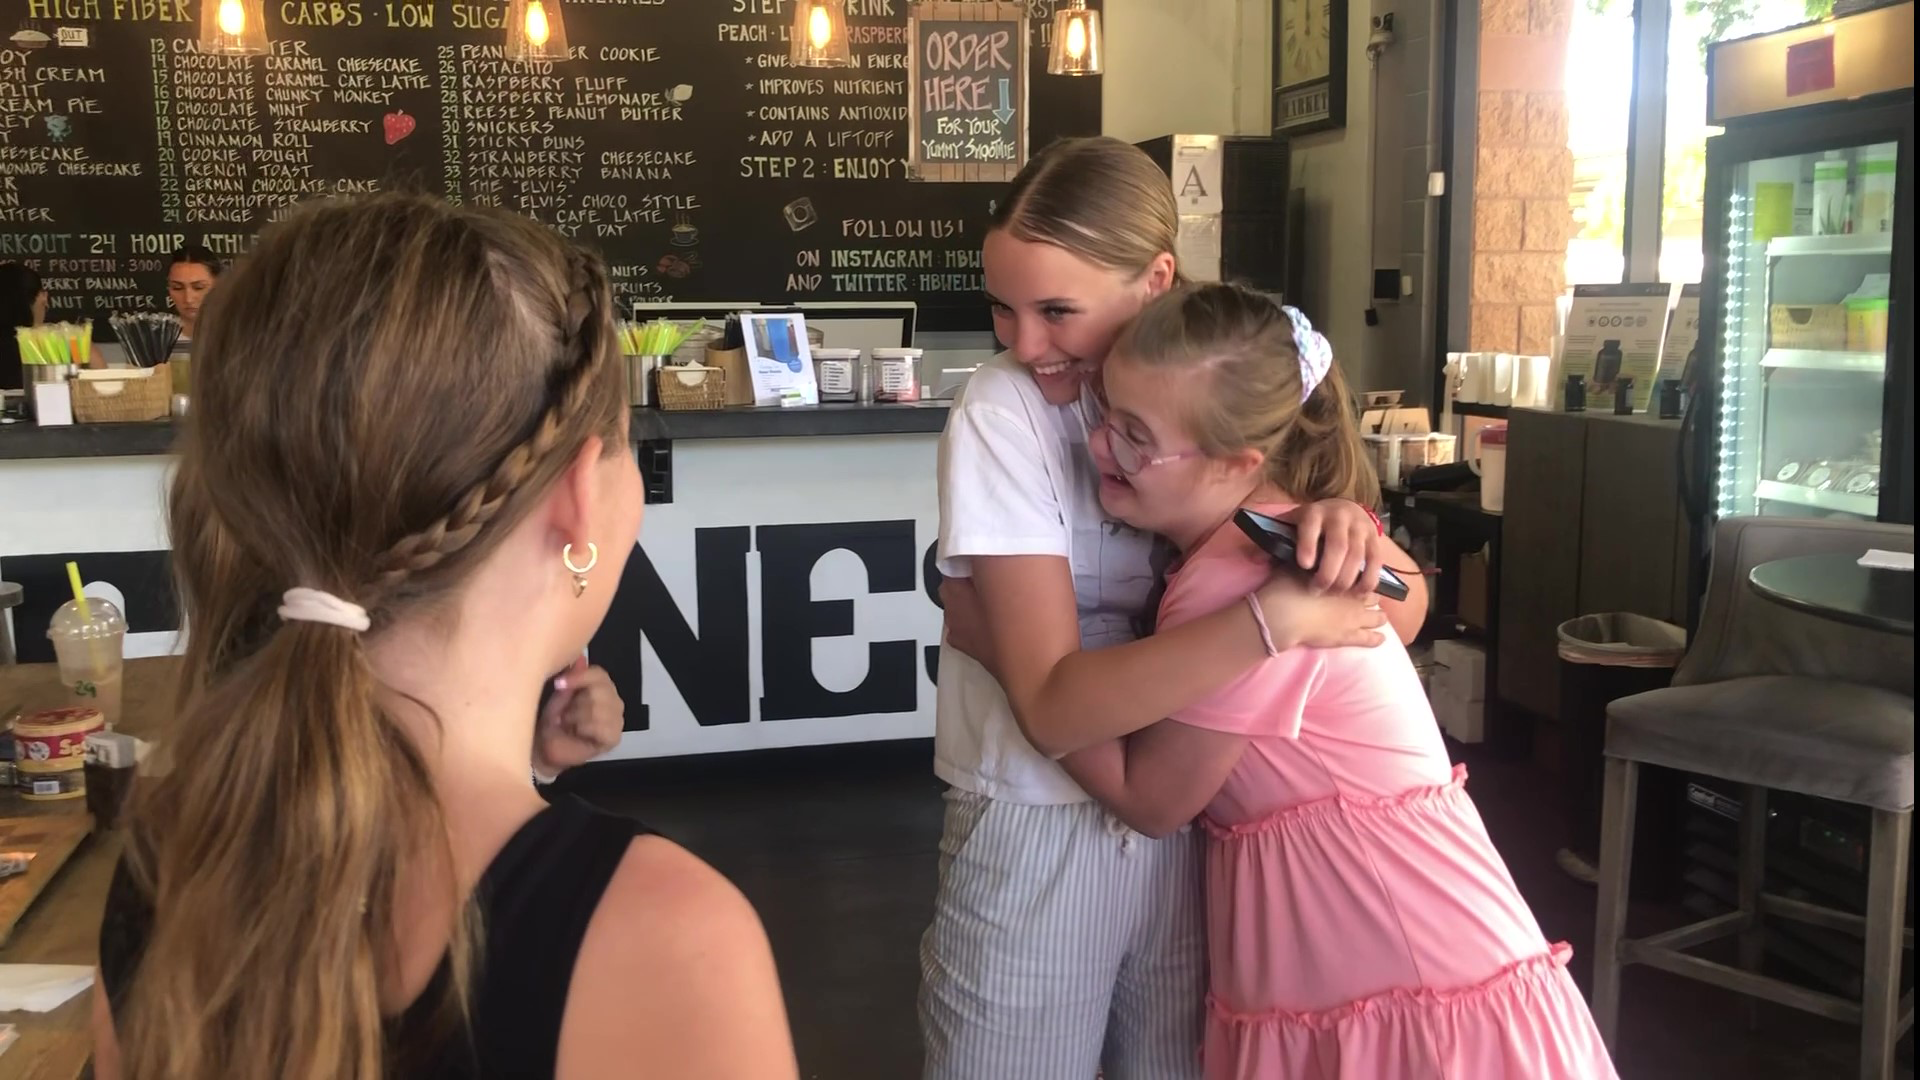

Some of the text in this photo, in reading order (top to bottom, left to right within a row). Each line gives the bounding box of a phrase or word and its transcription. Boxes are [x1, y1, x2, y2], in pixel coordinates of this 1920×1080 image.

[29, 0, 101, 19] HIGH
[113, 0, 194, 22] FIBER
[280, 1, 363, 26] CARBS
[387, 4, 434, 28] LOW
[846, 0, 895, 16] RINK
[61, 29, 84, 41] OUT
[718, 24, 768, 42] PEACH
[600, 46, 661, 62] COOKIE
[926, 31, 1012, 72] ORDER
[174, 55, 255, 71] CHOCOLATE
[265, 57, 328, 72] CARAMEL
[337, 58, 422, 74] CHEESECAKE
[0, 67, 105, 82] SH CREAM
[174, 71, 255, 86] CHOCOLATE
[265, 73, 330, 89] CARAMEL
[338, 75, 375, 89] CAFE
[381, 75, 431, 90] LATTE
[462, 74, 565, 91] RASPBERRY
[575, 76, 628, 91] FLUFF
[175, 86, 256, 101] CHOCOLATE
[265, 89, 323, 104] CHUNKY
[333, 90, 394, 106] MONKEY
[760, 79, 904, 96] IMPROVES NUTRIENT
[923, 74, 992, 113] HERE
[462, 90, 565, 105] RASPBERRY
[576, 92, 663, 107] LEMONADE
[176, 101, 258, 117] CHOCOLATE
[269, 103, 309, 118] MINT
[464, 105, 536, 120] REESE'S
[549, 106, 607, 121] PEANUT
[621, 106, 683, 121] BUTTER
[759, 105, 830, 122] CONTAINS
[177, 117, 262, 133] CHOCOLATE
[274, 119, 374, 135] STRAWBERRY
[465, 120, 555, 135] SNICKERS
[936, 116, 1001, 136] FOR YOUR
[178, 132, 263, 149] CINNAMON
[272, 132, 314, 149] ROLL
[467, 136, 532, 150] STICKY
[543, 136, 585, 150] BUNS
[760, 130, 793, 147] ADD
[804, 131, 817, 147] A
[182, 148, 242, 164] COOKIE
[252, 148, 309, 163] DOUGH
[921, 138, 964, 160] YUMMY
[466, 150, 586, 164] STRAWBERRY
[601, 151, 697, 166] CHEESECAKE
[58, 163, 142, 176] CHEESECAKE
[184, 163, 247, 178] FRENCH
[259, 164, 314, 178] TOAST
[467, 165, 583, 180] STRAWBERRY
[601, 165, 672, 181] BANANA
[740, 157, 797, 179] STEP
[834, 157, 898, 180] ENJOY
[185, 178, 243, 193] GERMAN
[252, 178, 326, 194] CHOCOLATE
[337, 178, 381, 194] CAKE
[469, 180, 503, 194] THE
[1180, 164, 1208, 196] A
[472, 195, 503, 208] THE
[582, 195, 627, 209] CHOCO
[642, 195, 702, 210] STYLE
[186, 208, 253, 223] ORANGE
[556, 210, 601, 224] CAFE
[614, 210, 666, 224] LATTE
[597, 224, 628, 238] DAY
[842, 219, 964, 238] FOLLOW US!
[131, 233, 185, 255] HOUR
[50, 258, 117, 273] PROTEIN
[796, 250, 821, 267] ON
[611, 264, 649, 277] NUTS
[85, 277, 138, 291] BANANA
[786, 273, 823, 292] AND
[95, 295, 153, 310] BUTTER
